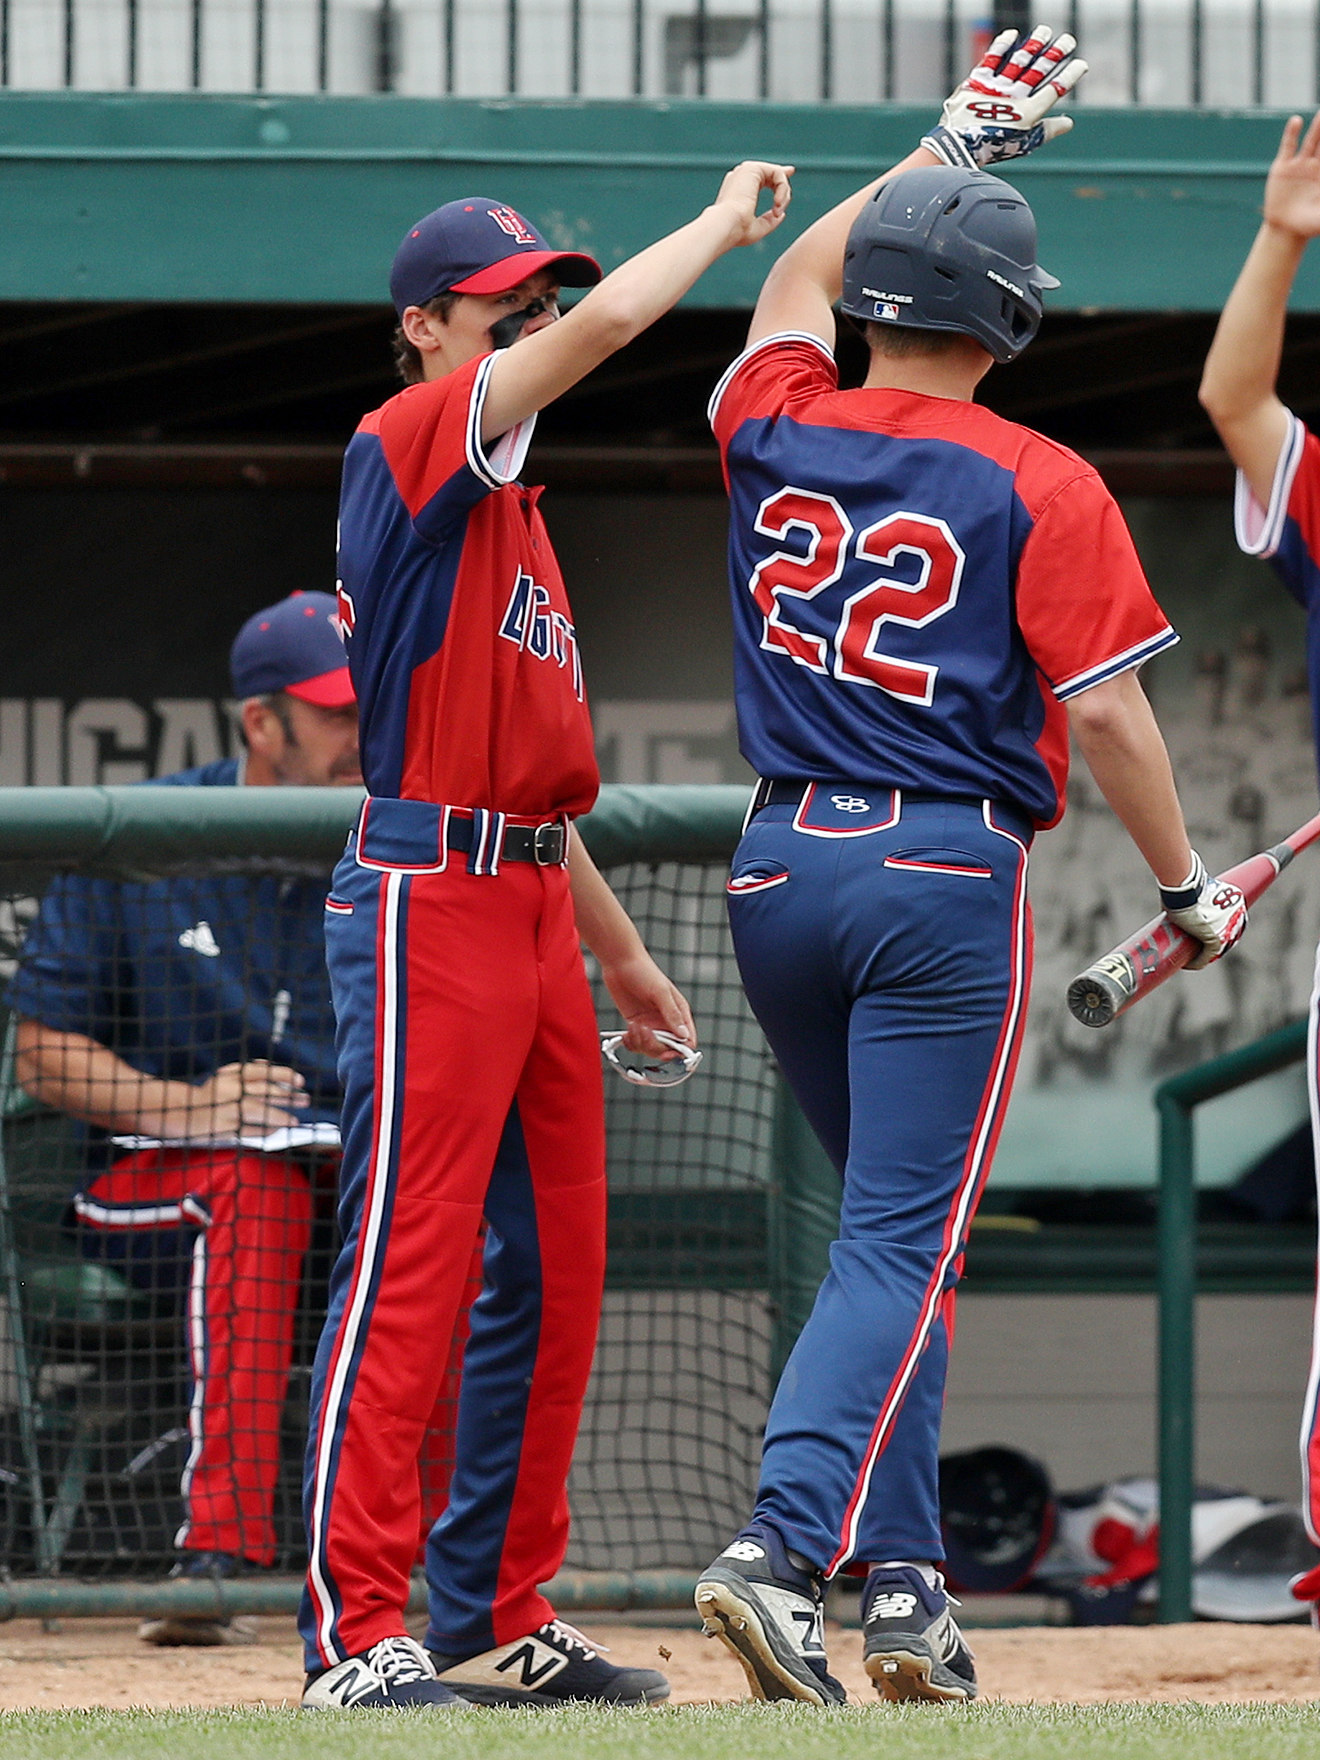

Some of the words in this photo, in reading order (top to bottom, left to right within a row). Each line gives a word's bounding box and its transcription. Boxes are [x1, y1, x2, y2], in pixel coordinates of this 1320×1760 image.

[861, 286, 915, 305] RAWLINGS
[749, 485, 966, 708] 22
[494, 1642, 562, 1687] N
